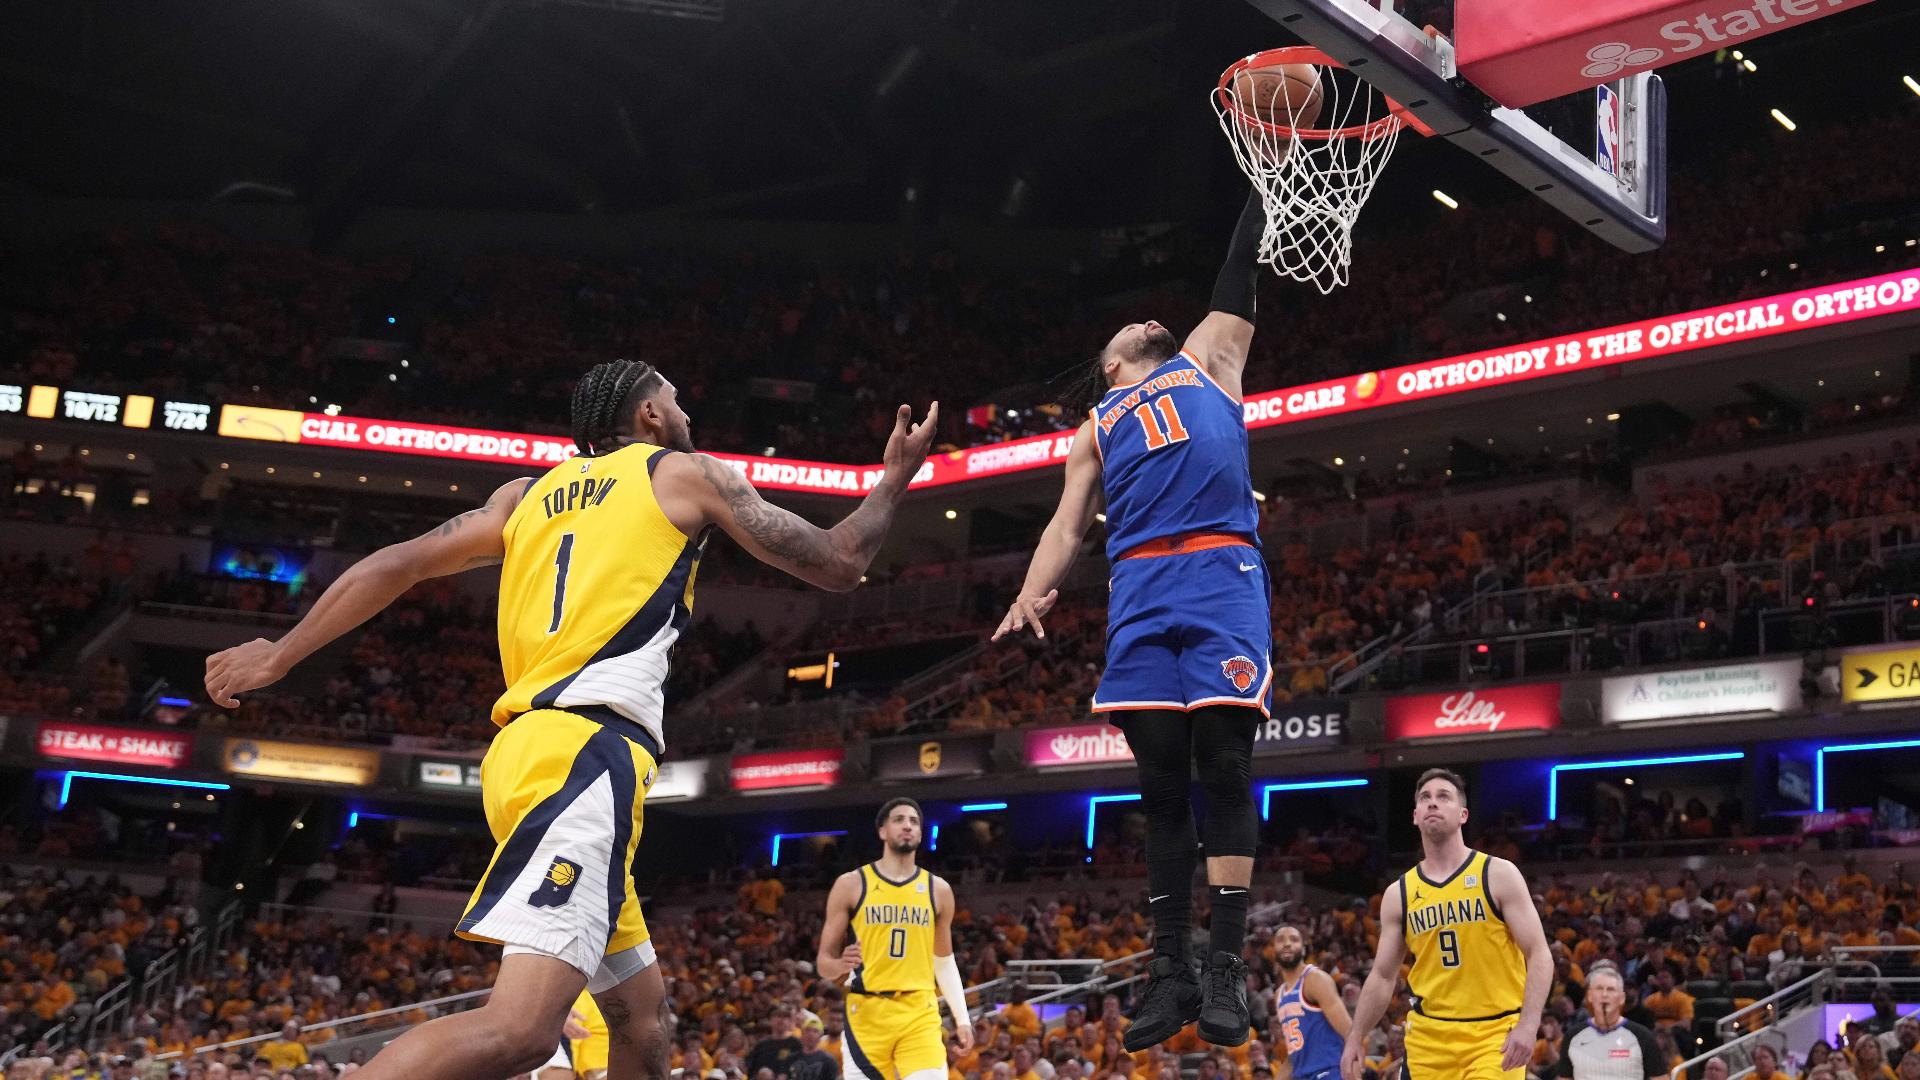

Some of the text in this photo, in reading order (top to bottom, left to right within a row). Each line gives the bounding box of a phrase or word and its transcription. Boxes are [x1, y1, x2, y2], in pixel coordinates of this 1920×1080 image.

[1397, 277, 1920, 395] ORTHOINDY IS THE OFFICIAL ORTHOP
[1099, 369, 1204, 436] NEW YORK
[1286, 386, 1346, 413] CARE
[301, 418, 361, 442] CIAL
[365, 425, 526, 458] ORTHOPEDIC
[1134, 393, 1190, 450] 11
[752, 461, 859, 490] INDIANA
[546, 532, 576, 635] 1
[1657, 667, 1761, 687] Peyton Manning
[1657, 680, 1777, 702] Children's Hospital
[1434, 691, 1506, 732] Lilly
[40, 729, 103, 751] STEAK
[120, 736, 184, 759] SHAKE
[1079, 728, 1128, 758] mhs
[865, 904, 930, 926] INDIANA
[1408, 897, 1486, 934] INDIANA
[889, 927, 907, 960] 0
[1438, 929, 1461, 968] 9
